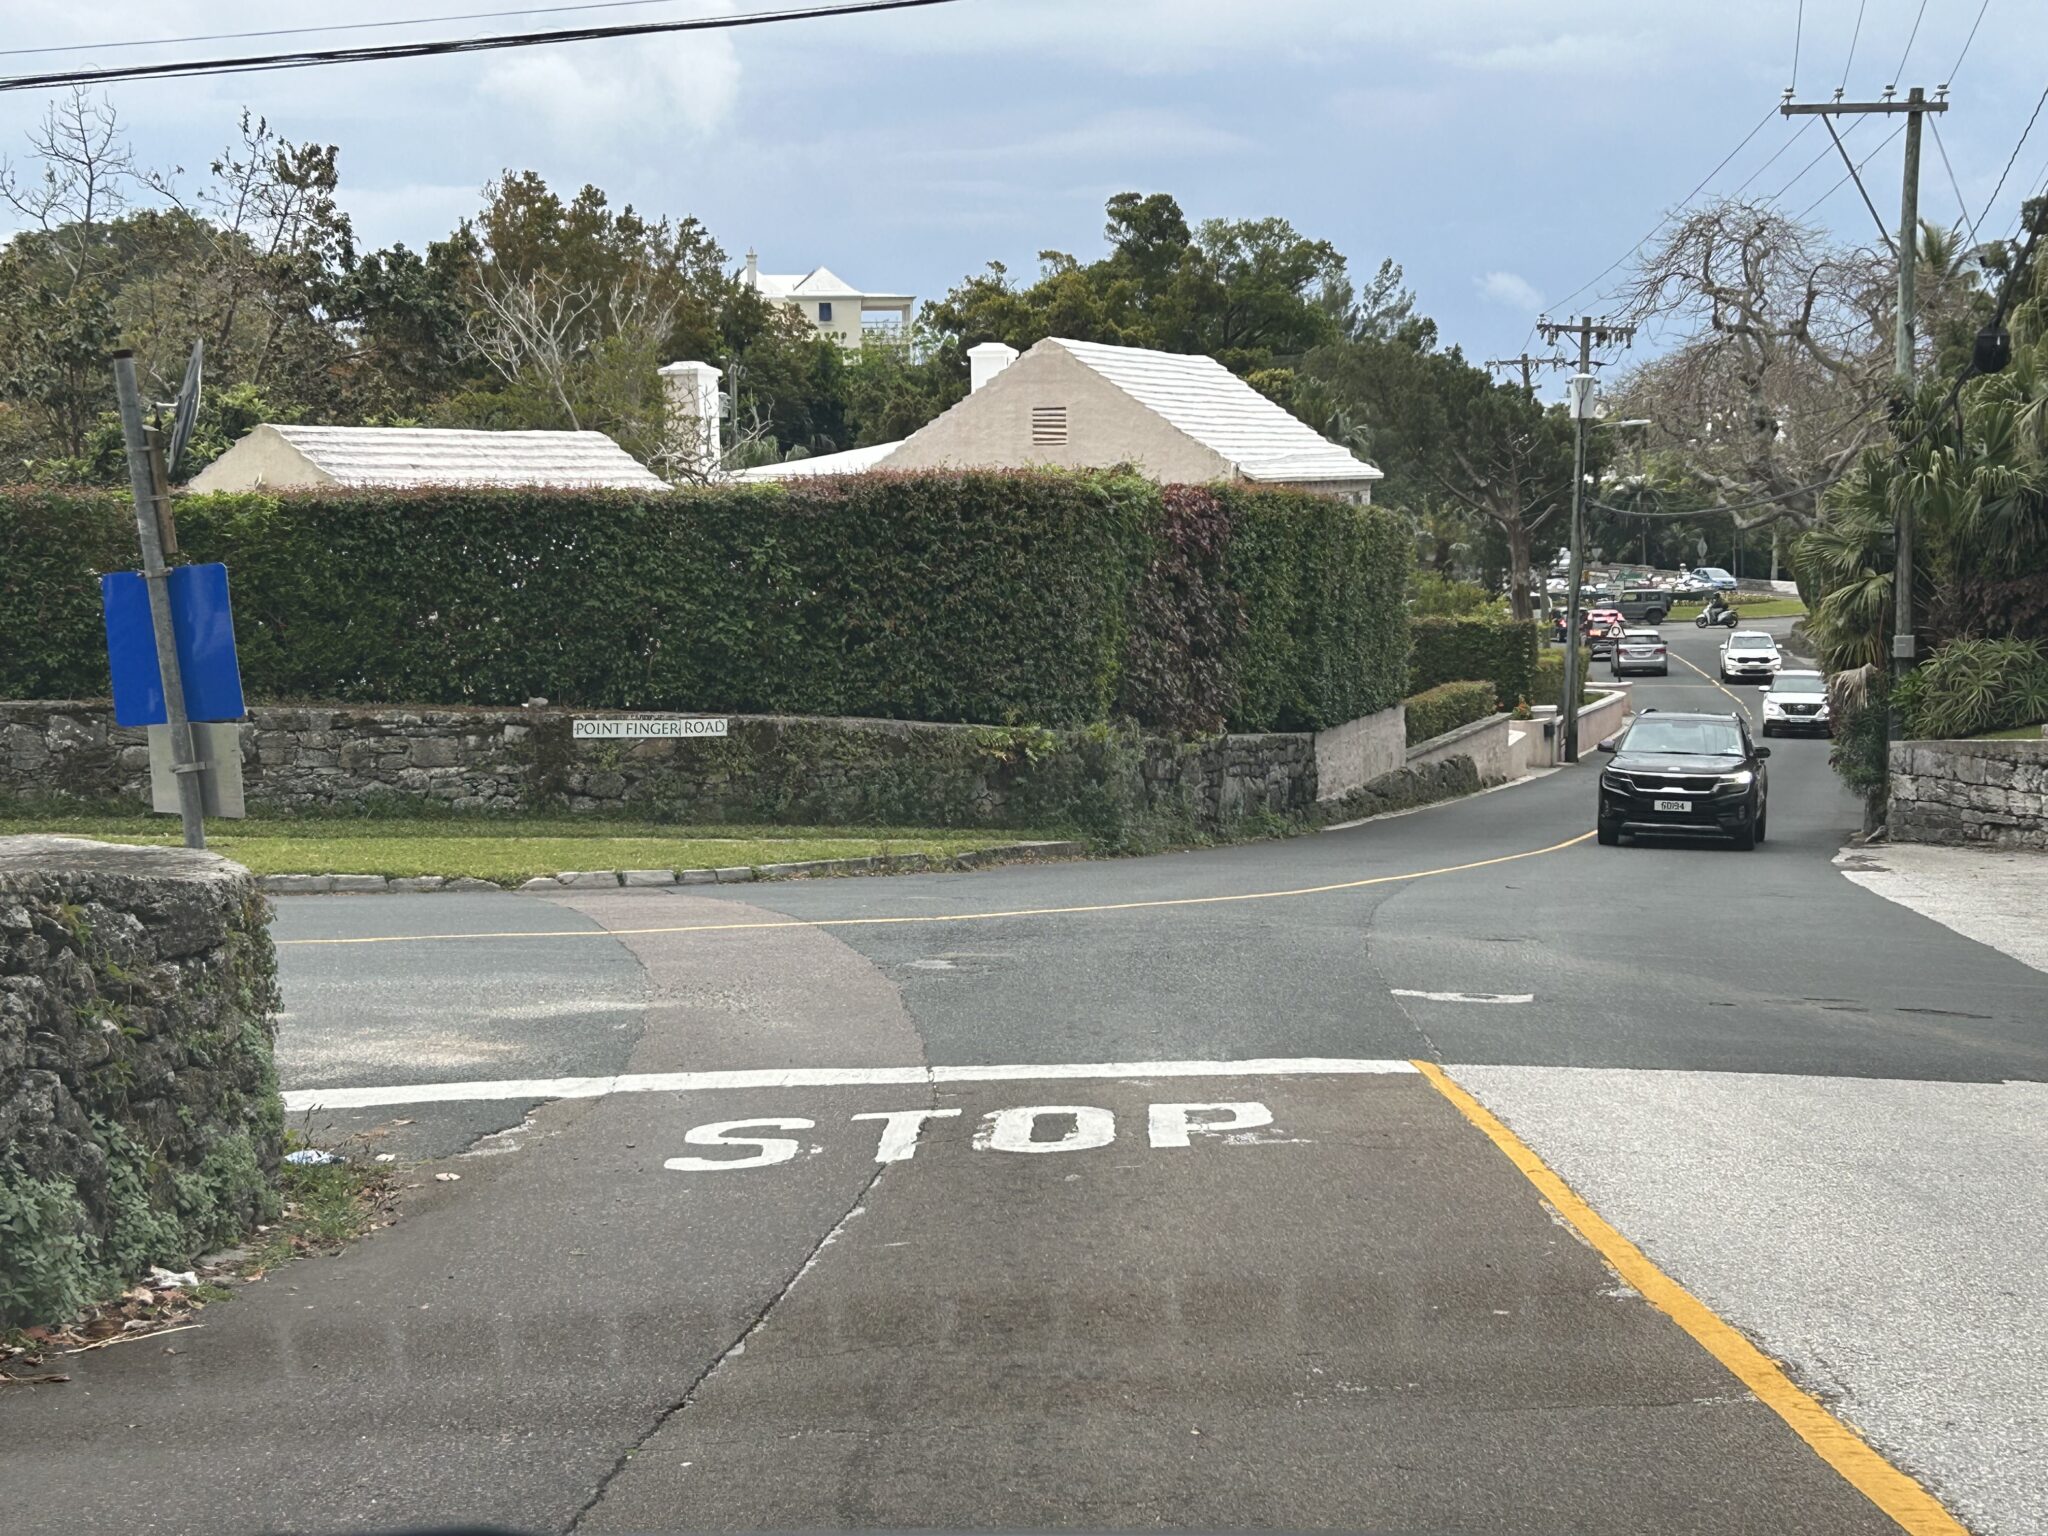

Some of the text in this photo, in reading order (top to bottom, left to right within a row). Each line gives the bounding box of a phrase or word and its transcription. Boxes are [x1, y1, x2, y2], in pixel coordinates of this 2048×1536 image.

[576, 720, 725, 735] POINT FINGER ROAD
[663, 1101, 1274, 1172] STOP
